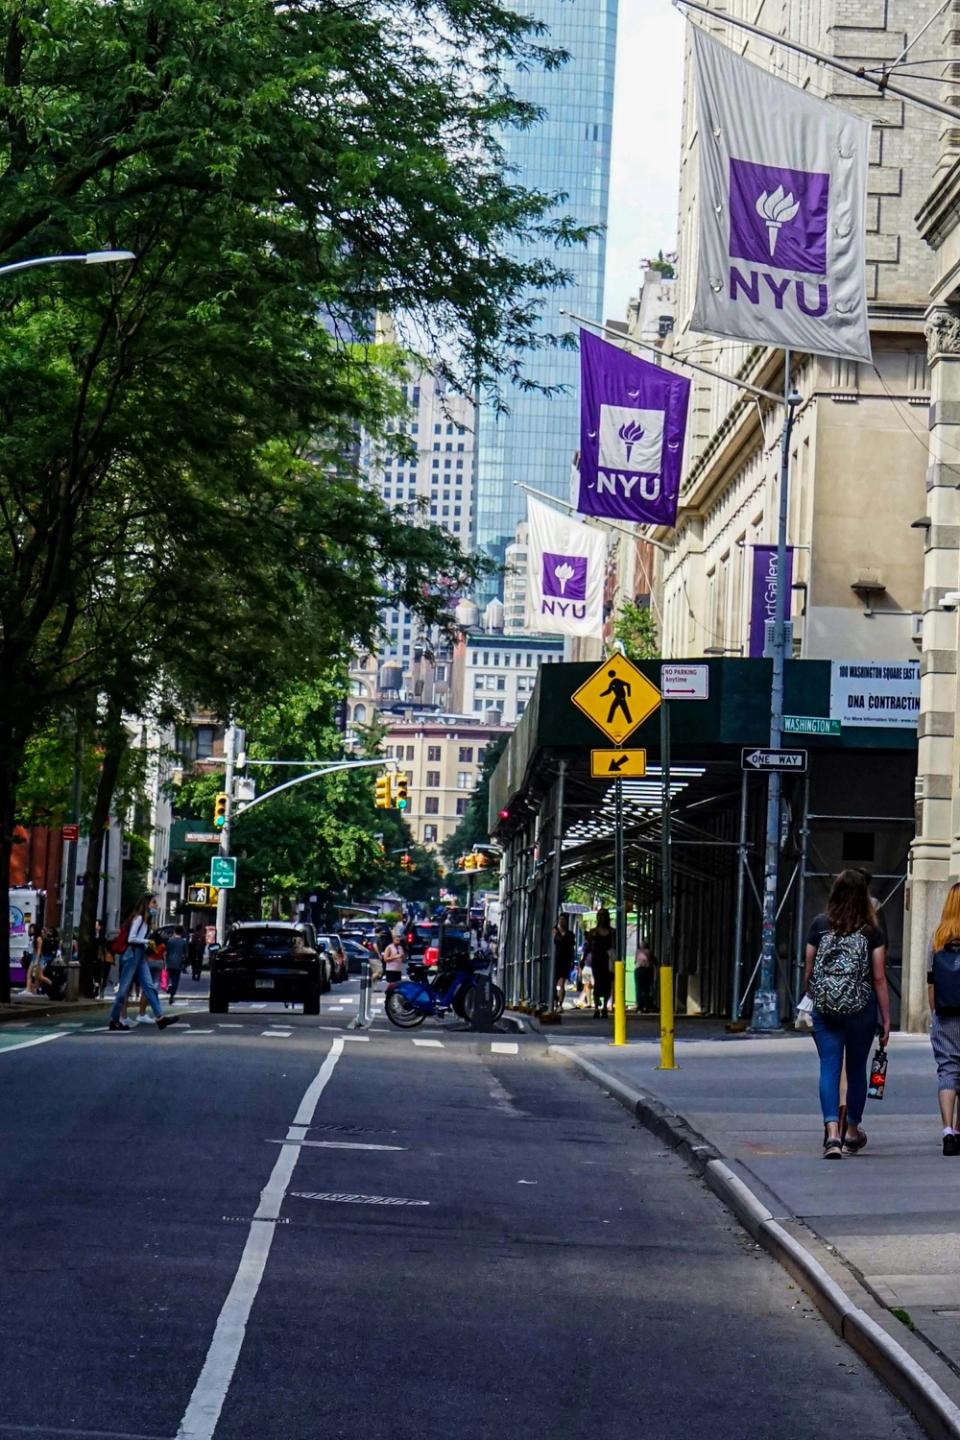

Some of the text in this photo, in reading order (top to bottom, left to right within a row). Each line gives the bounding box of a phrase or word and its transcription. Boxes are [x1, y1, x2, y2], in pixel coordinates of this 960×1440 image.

[730, 266, 828, 317] NYU
[597, 471, 660, 500] NYU
[542, 600, 586, 619] NYU
[840, 666, 848, 678] 100
[850, 666, 882, 679] WASHINGTON
[883, 667, 902, 680] SQUARE
[903, 668, 915, 680] EAST
[848, 695, 864, 708] DNA
[784, 718, 830, 733] WASHINGTON
[752, 754, 798, 764] ONE WAY
